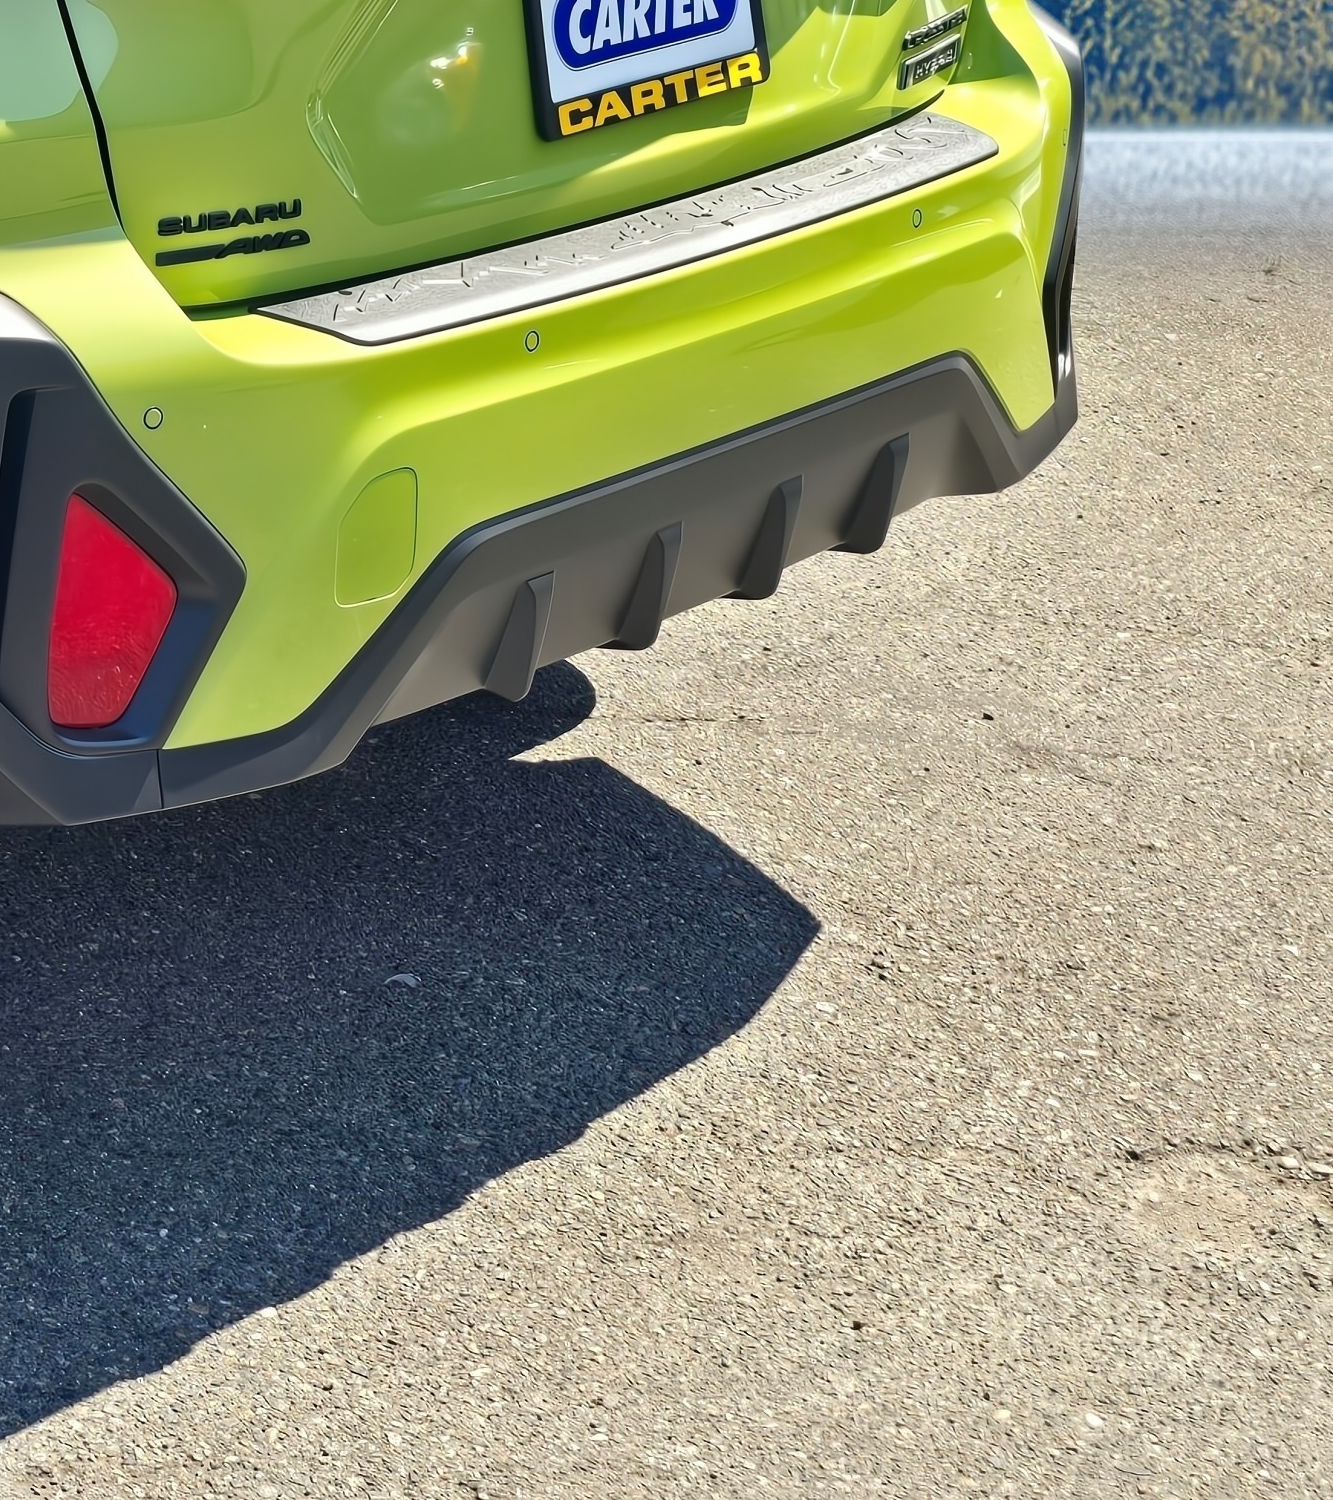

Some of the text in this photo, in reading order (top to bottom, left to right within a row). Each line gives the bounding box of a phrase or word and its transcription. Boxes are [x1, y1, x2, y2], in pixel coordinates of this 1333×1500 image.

[558, 52, 763, 136] CARTER
[157, 198, 302, 236] SUBARU
[214, 228, 311, 259] AWD
